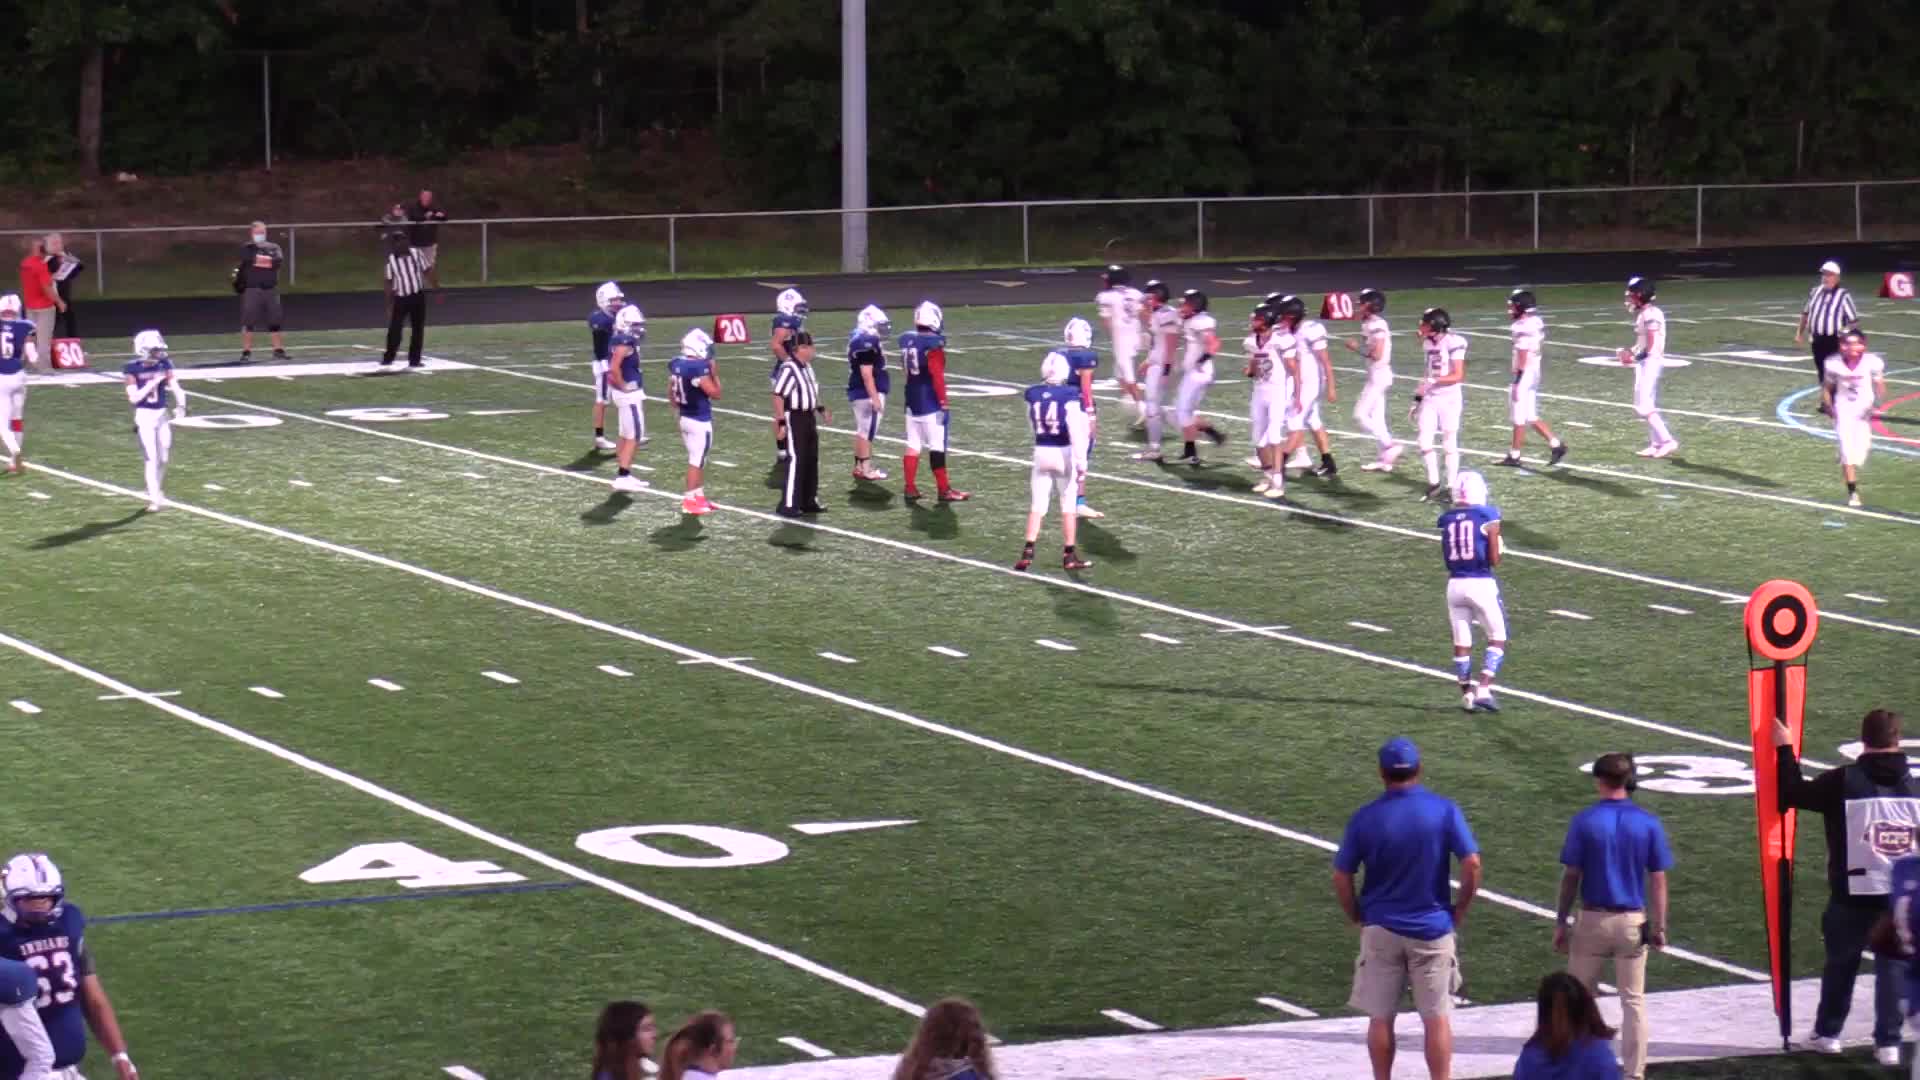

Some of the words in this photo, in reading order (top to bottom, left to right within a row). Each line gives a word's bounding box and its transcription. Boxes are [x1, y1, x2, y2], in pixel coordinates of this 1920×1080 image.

[1890, 274, 1913, 297] G
[1330, 294, 1353, 319] 10
[720, 318, 746, 342] 20
[0, 331, 15, 359] 6
[56, 342, 84, 367] 30
[1033, 401, 1060, 435] 14
[1448, 520, 1474, 561] 10
[298, 824, 790, 889] 40
[19, 935, 70, 956] INDIANS
[25, 951, 78, 1008] 63
